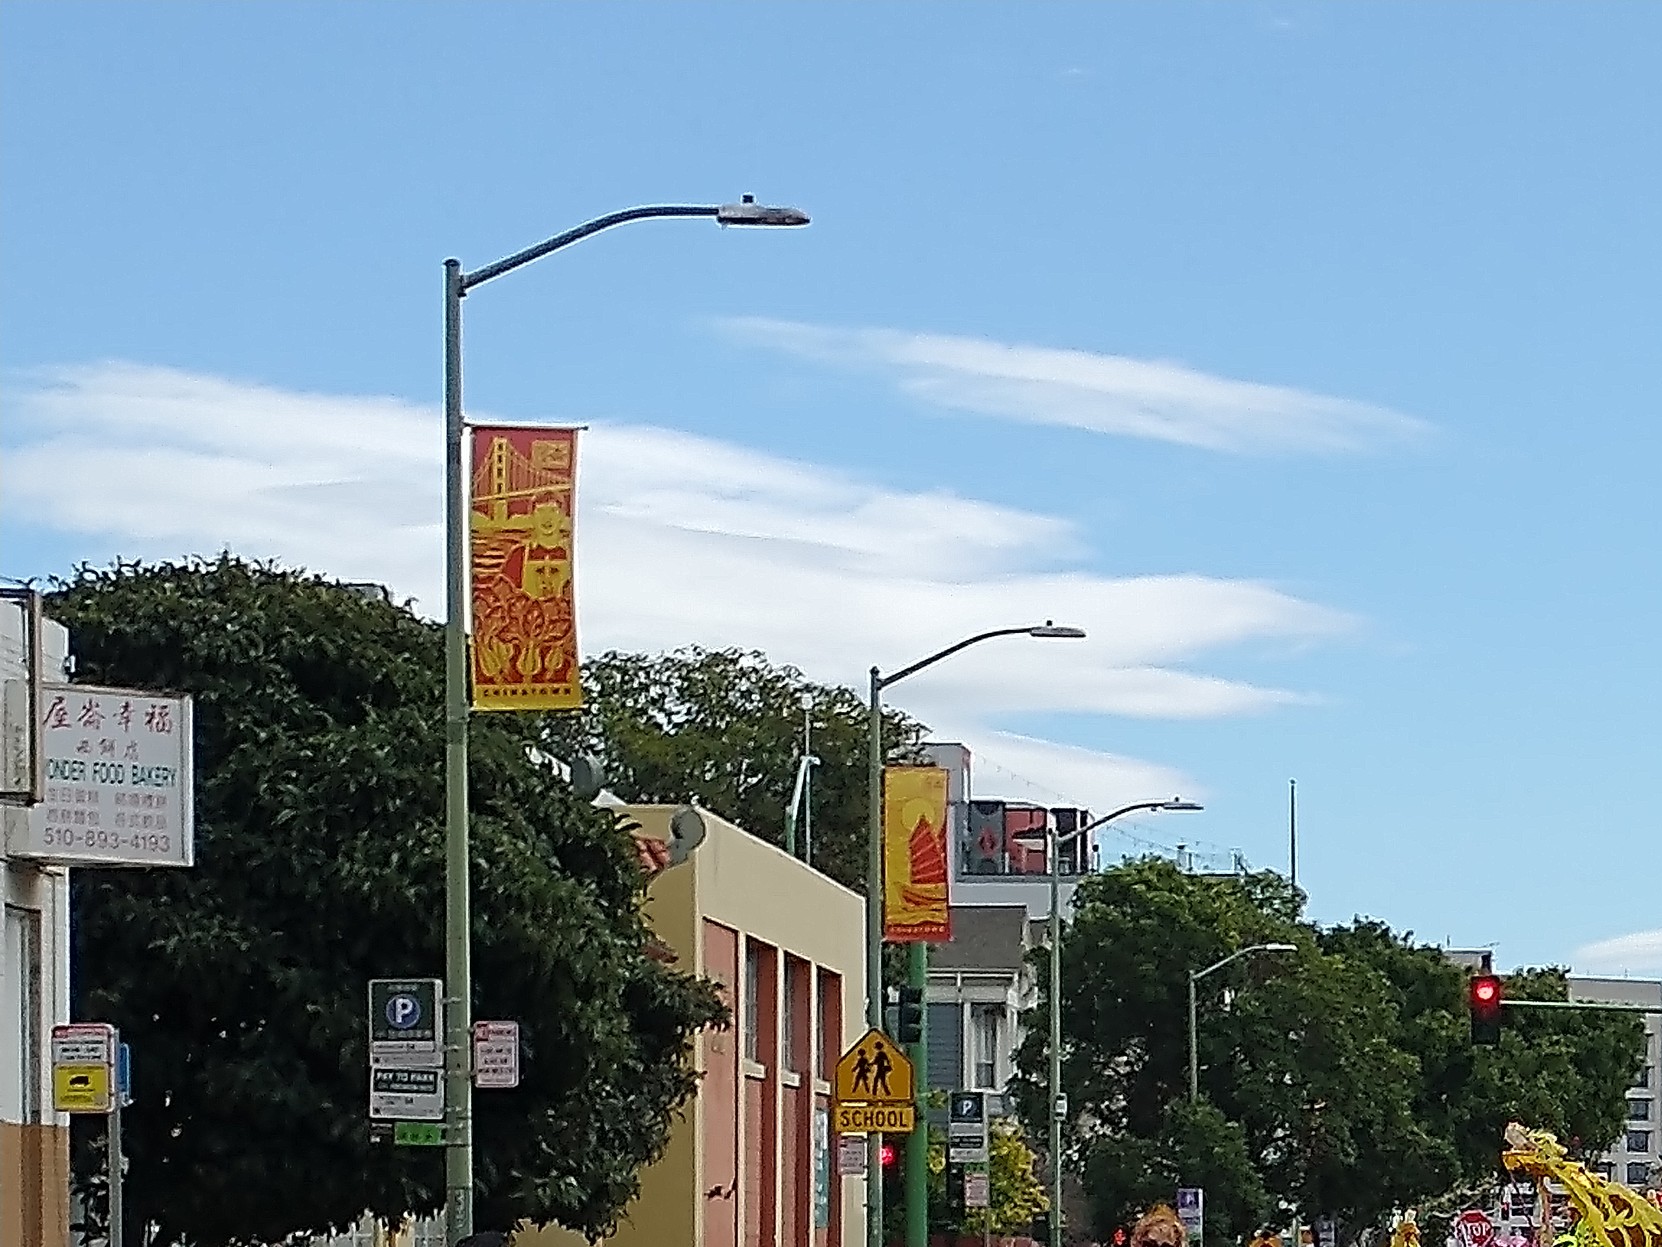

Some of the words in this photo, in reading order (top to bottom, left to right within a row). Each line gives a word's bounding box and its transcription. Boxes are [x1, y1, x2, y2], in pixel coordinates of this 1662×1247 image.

[93, 762, 125, 785] FOOD
[131, 764, 178, 787] BAKERY
[43, 827, 171, 853] 510-893-4193
[395, 998, 413, 1023] P
[840, 1110, 908, 1128] SCHOOL
